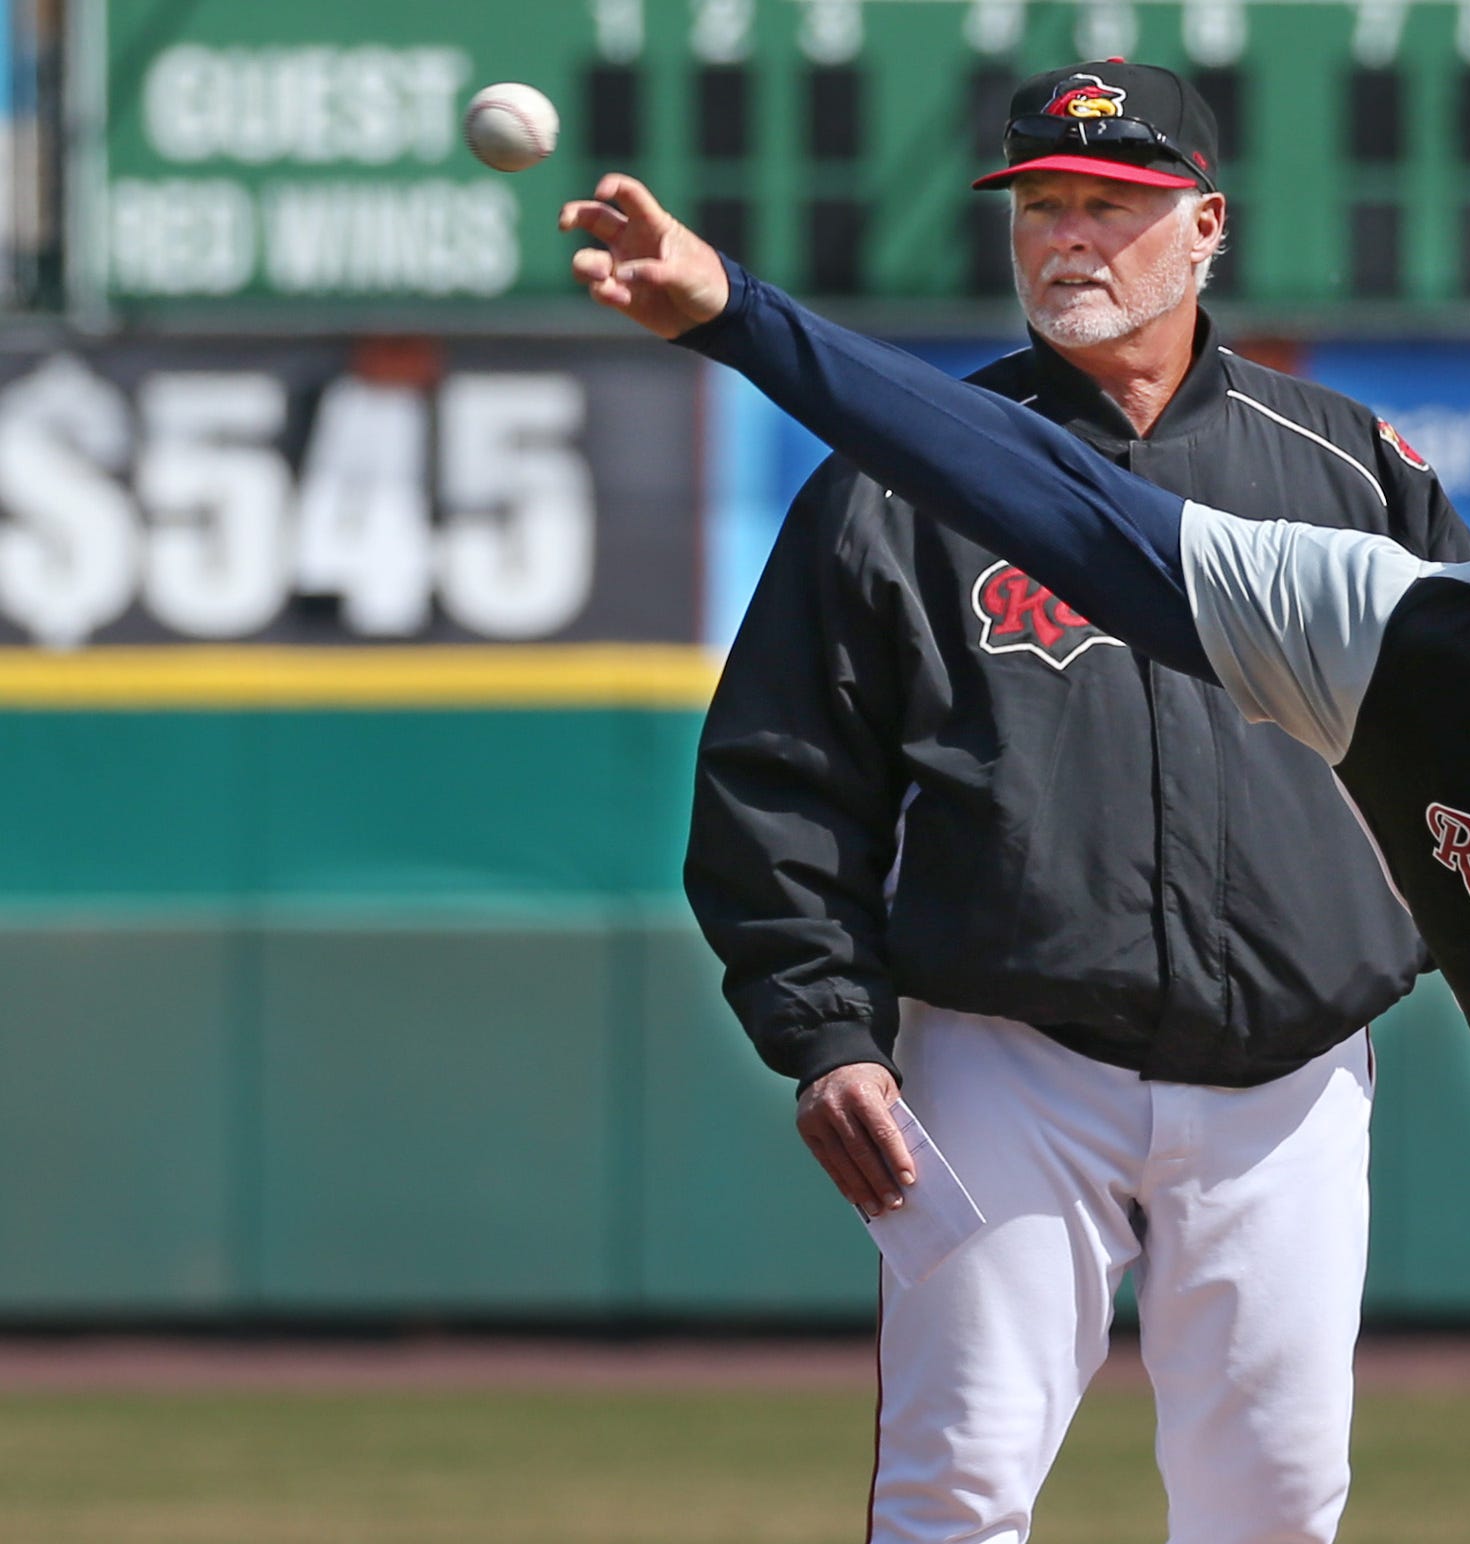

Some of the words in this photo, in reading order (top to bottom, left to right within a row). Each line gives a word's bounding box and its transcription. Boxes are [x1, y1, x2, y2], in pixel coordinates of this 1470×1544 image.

[145, 44, 469, 163] GUEST
[110, 178, 258, 295] RED
[264, 178, 519, 296] WINGS
[0, 352, 596, 650] $545
